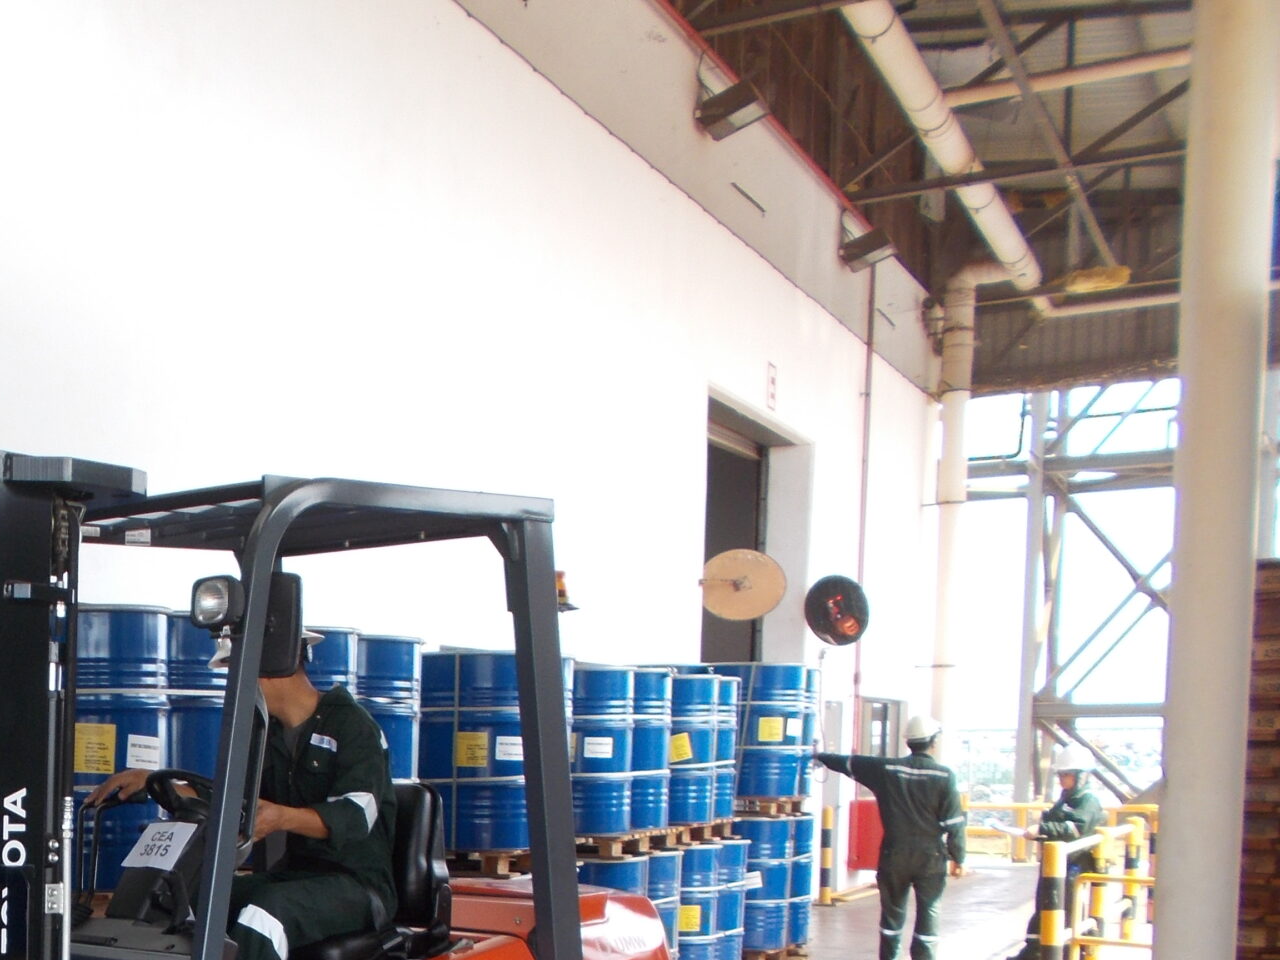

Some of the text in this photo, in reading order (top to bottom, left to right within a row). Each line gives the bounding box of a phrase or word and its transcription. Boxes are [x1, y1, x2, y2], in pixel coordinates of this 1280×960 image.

[151, 831, 174, 842] CEA
[140, 844, 171, 857] 3815
[1, 788, 27, 954] OTA
